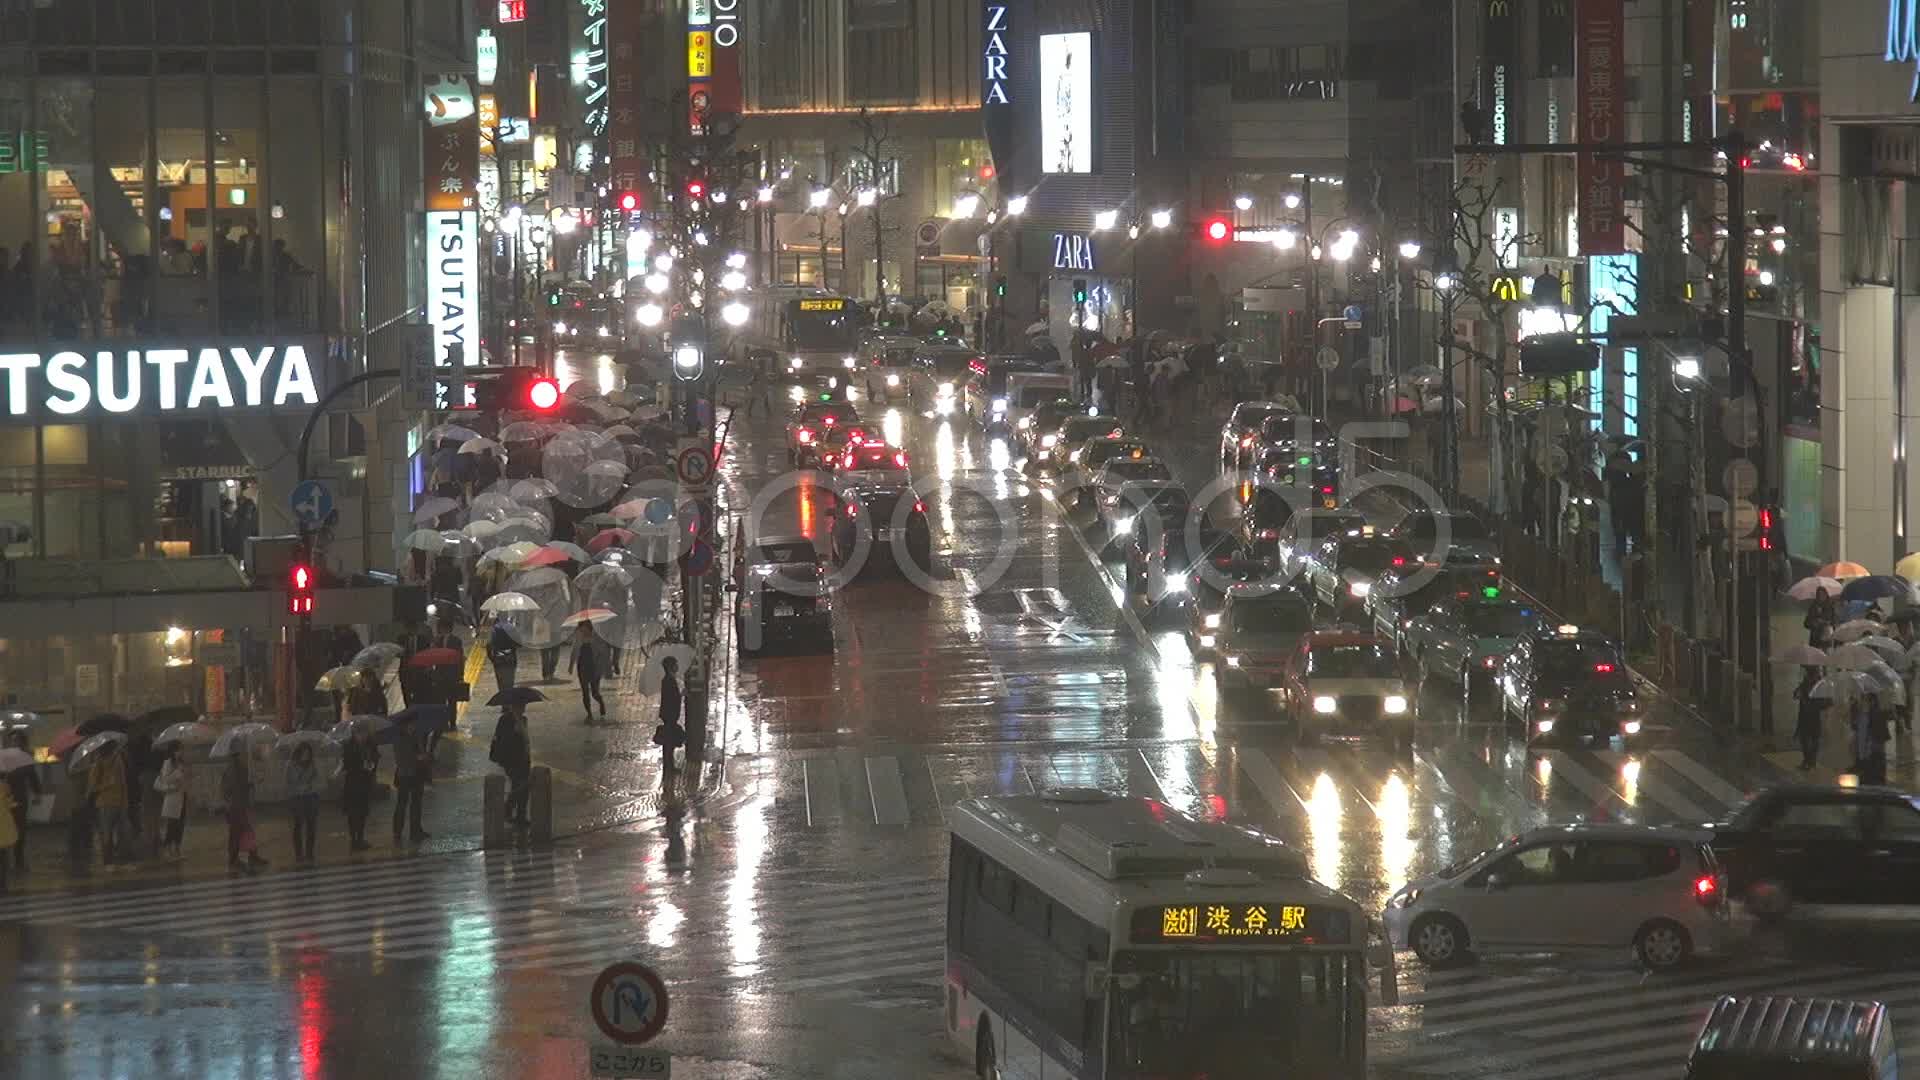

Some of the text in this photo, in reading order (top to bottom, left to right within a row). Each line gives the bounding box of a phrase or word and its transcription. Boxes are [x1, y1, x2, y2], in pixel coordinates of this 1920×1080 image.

[986, 7, 1009, 104] ZARA
[1587, 19, 1615, 233] 三菱東京UJ銀行
[1055, 235, 1093, 270] ZARA
[0, 345, 320, 415] TSUTAYA
[1206, 906, 1306, 929] 渋谷駅
